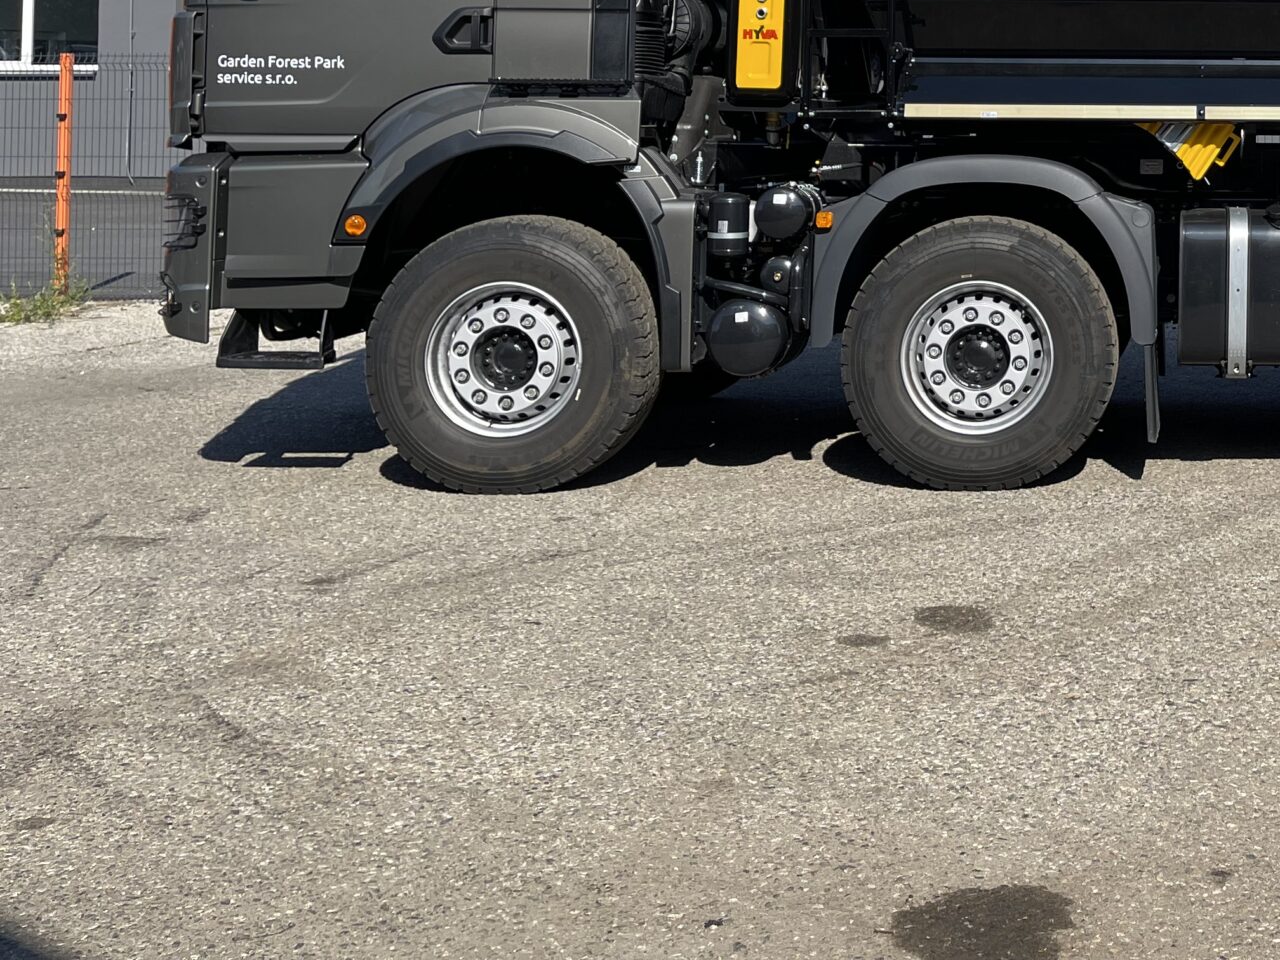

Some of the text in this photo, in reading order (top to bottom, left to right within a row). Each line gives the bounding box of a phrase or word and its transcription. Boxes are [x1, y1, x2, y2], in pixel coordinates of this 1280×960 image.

[742, 25, 778, 40] HYVA
[217, 54, 345, 69] Garden Forest Park
[216, 71, 298, 85] service s.r.o.
[911, 429, 1022, 462] MICHELIN
